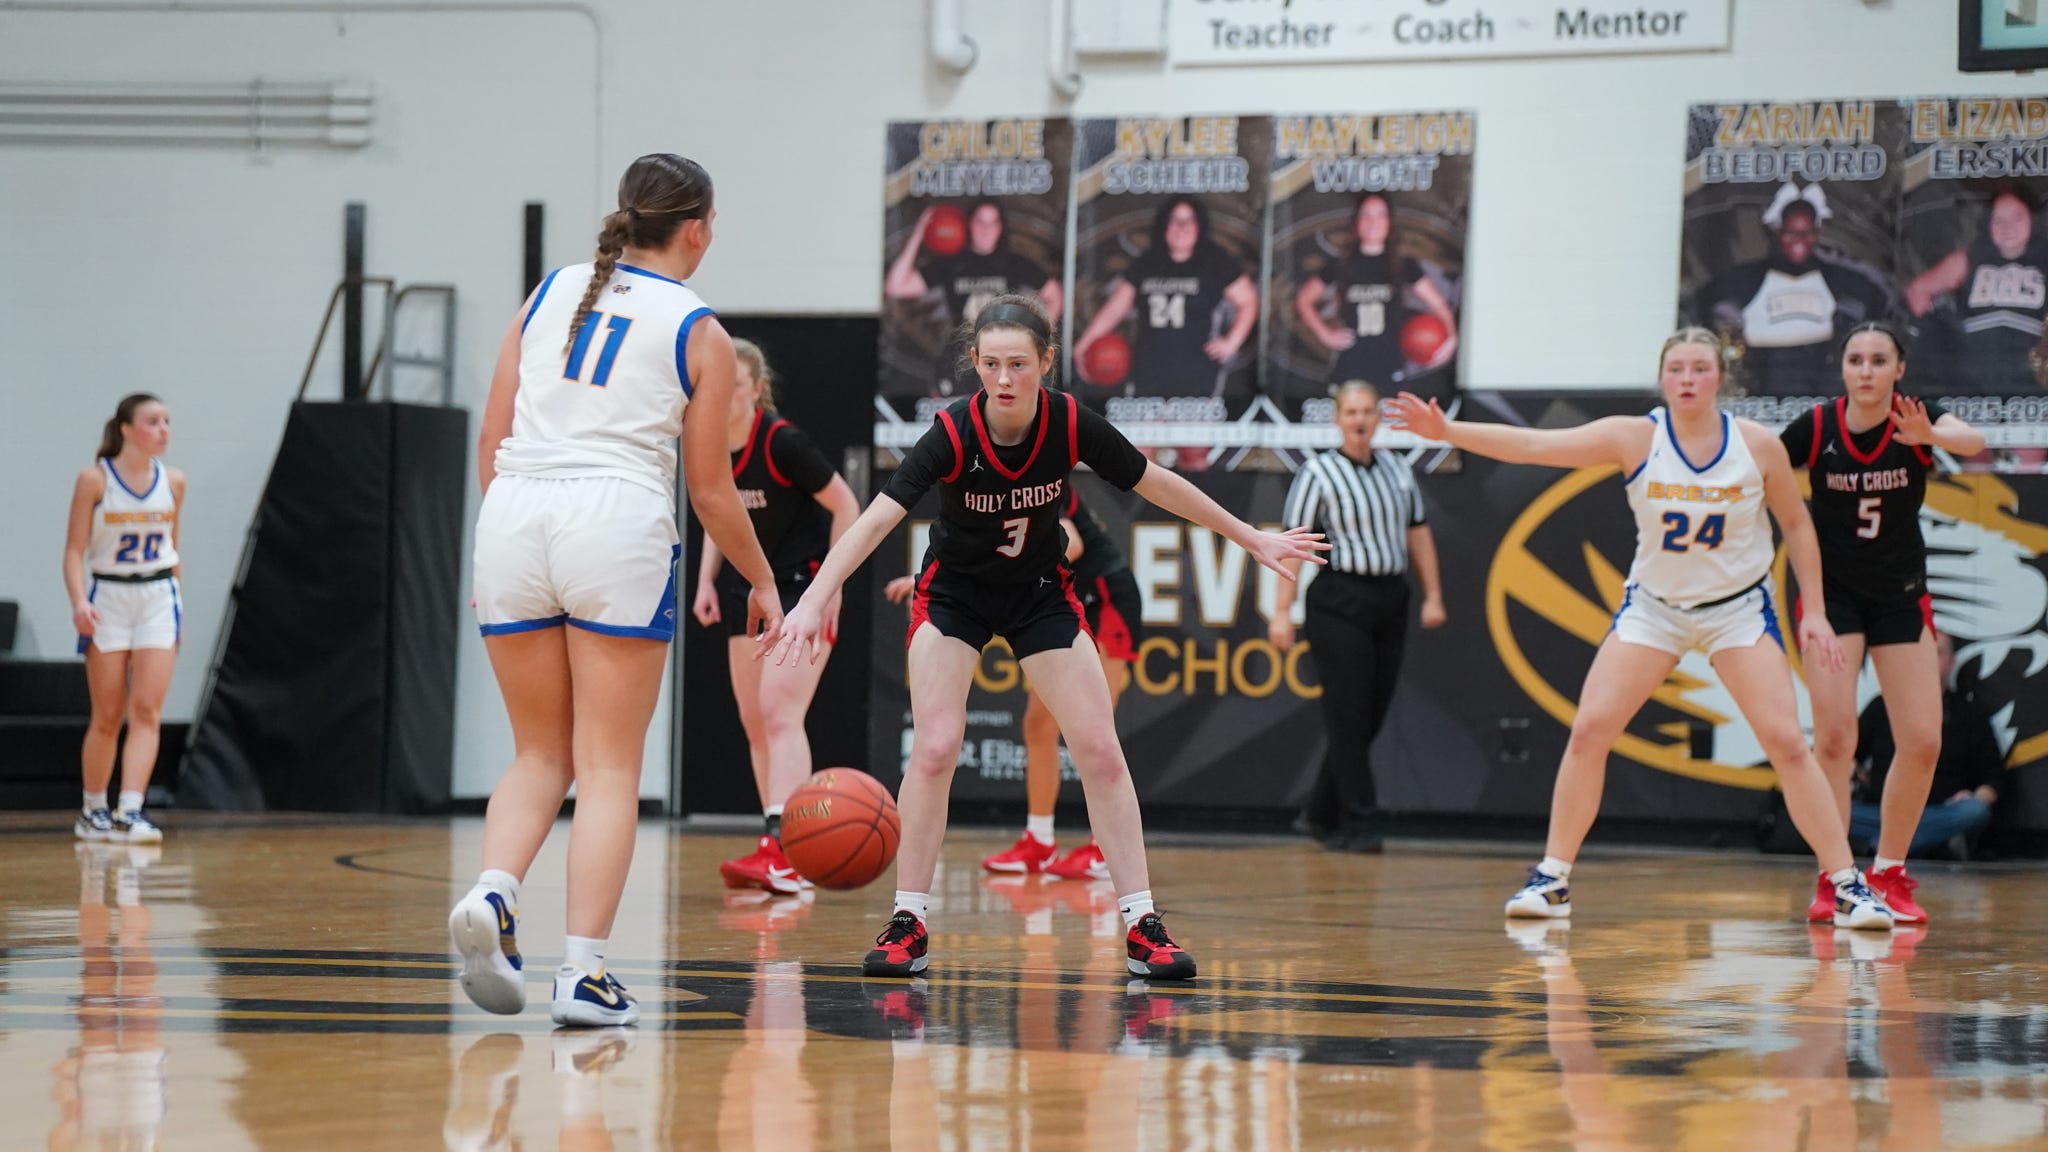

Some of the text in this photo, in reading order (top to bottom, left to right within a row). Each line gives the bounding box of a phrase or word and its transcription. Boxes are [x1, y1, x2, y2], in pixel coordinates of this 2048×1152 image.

[1209, 8, 1687, 49] Teacher Coach Mentor
[920, 119, 1044, 159] CHLOE
[1116, 117, 1239, 157] KYLEE
[1277, 113, 1472, 156] HAYLEIGH
[1716, 102, 1876, 147] ZARIAH
[911, 159, 1053, 197] MEYERS
[1103, 156, 1249, 193] SCHEHR
[1313, 155, 1439, 193] WIGHT
[1703, 144, 1887, 182] BEDFORD
[561, 309, 635, 389] 11
[965, 478, 1063, 513] HOLY CROSS
[1826, 467, 1909, 492] HOLY CROSS
[996, 517, 1029, 558] 3
[1660, 511, 1727, 552] 24
[1856, 497, 1882, 540] 5
[115, 532, 164, 565] 20
